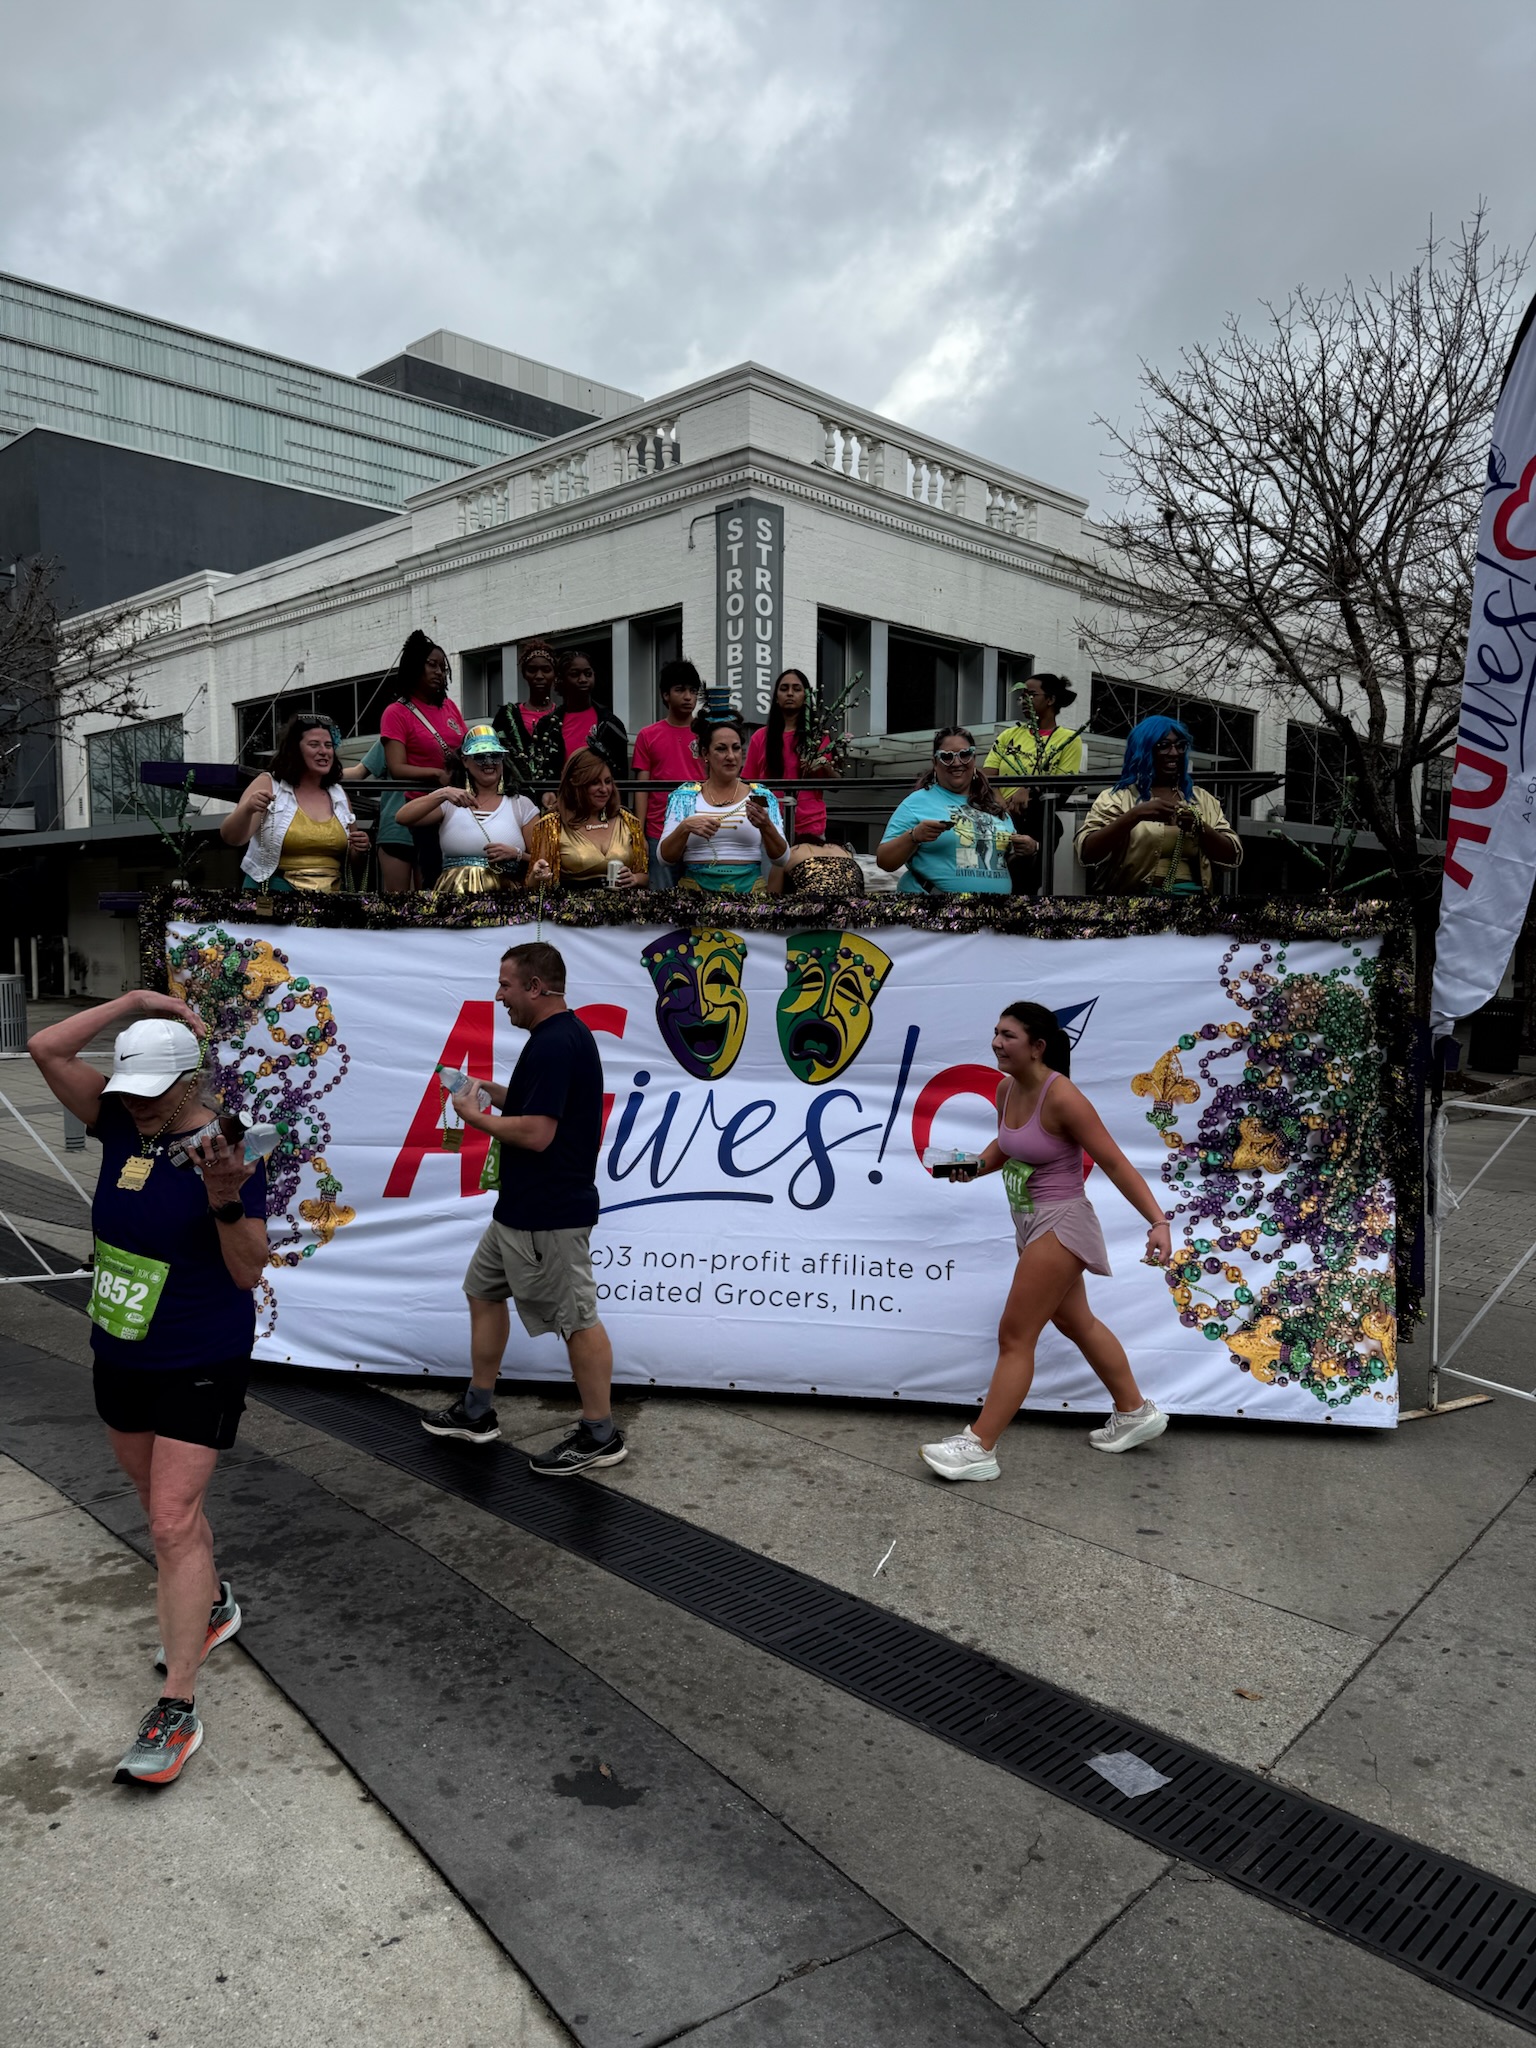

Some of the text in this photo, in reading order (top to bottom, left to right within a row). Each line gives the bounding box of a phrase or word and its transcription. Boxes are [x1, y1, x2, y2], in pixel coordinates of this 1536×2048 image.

[726, 517, 744, 716] STROUBES
[755, 517, 774, 715] STROUBES
[1003, 1170, 1022, 1195] 1411
[643, 1250, 790, 1274] non-profit
[801, 1252, 914, 1279] affiliate
[926, 1259, 956, 1281] of
[714, 1283, 838, 1313] Grocers,
[851, 1289, 902, 1313] Inc.
